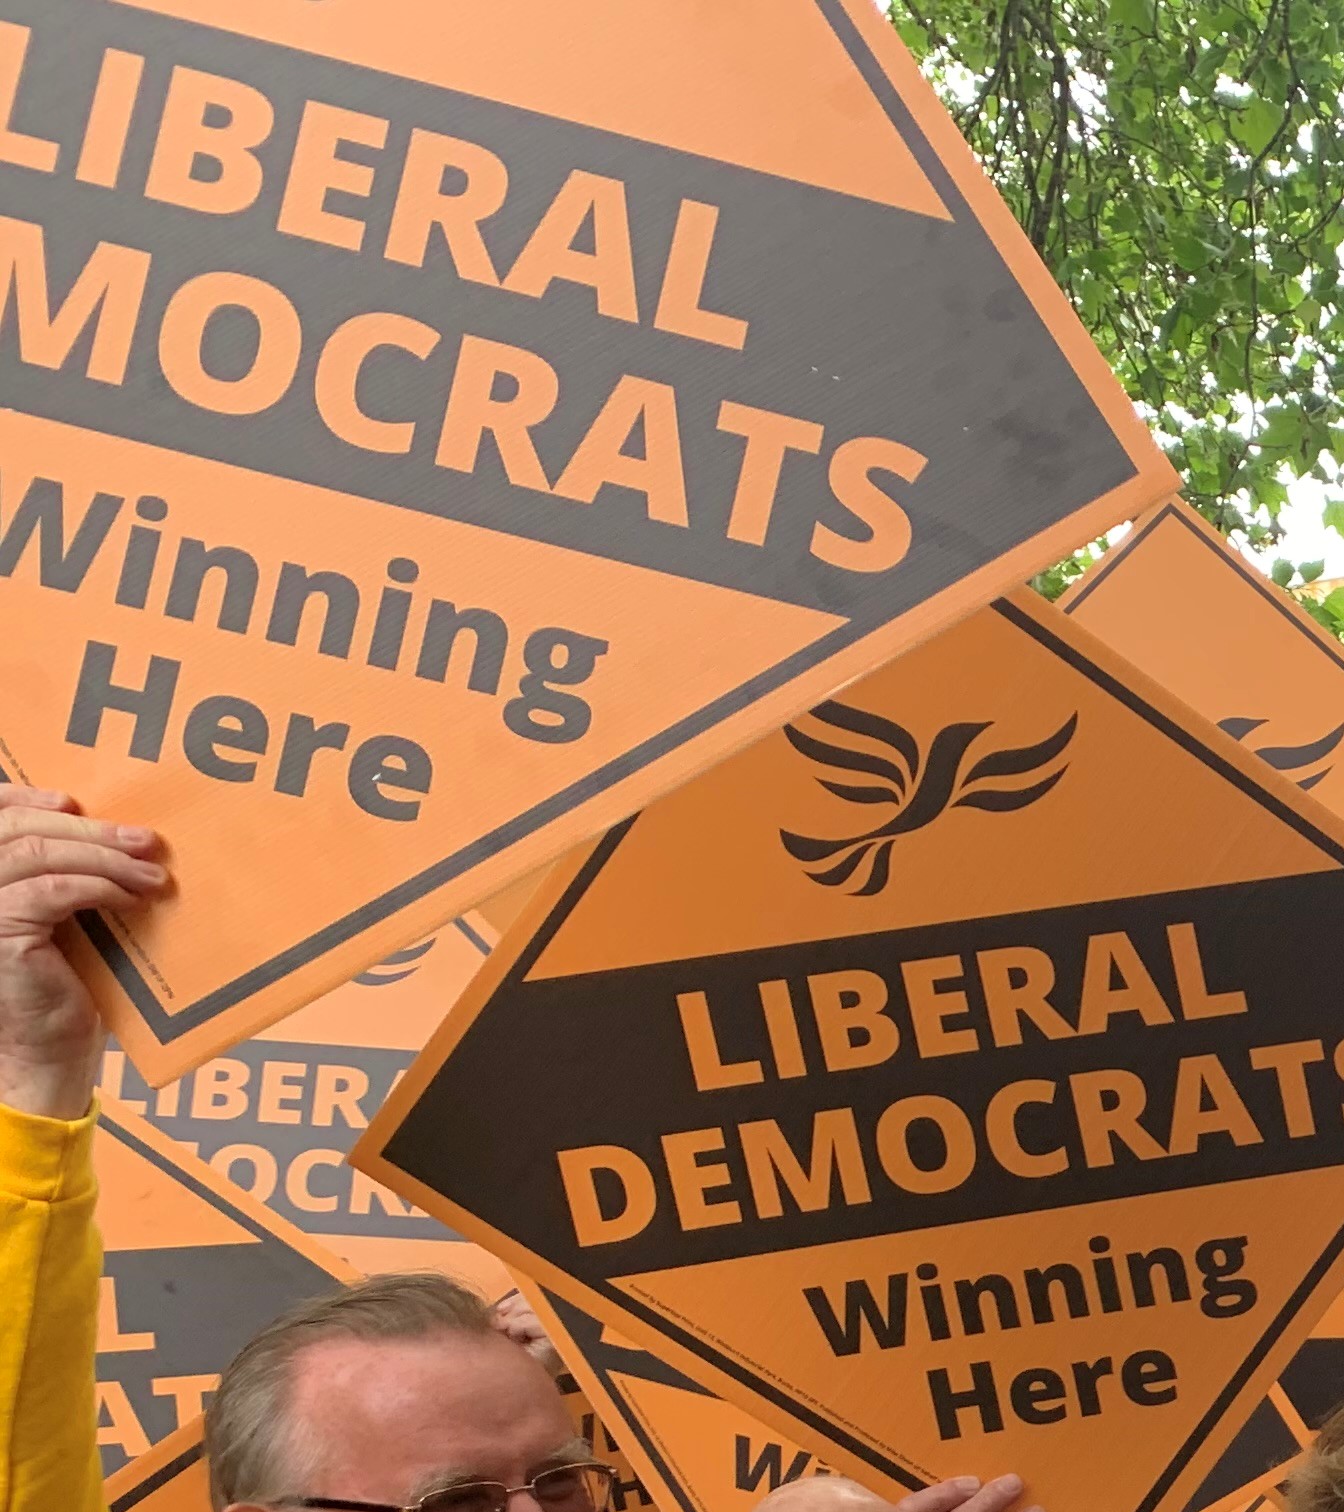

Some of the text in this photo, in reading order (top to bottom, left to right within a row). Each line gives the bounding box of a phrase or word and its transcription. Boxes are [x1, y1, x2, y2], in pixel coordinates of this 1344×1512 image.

[0, 475, 609, 744] Winning
[64, 639, 433, 822] Here
[676, 923, 1249, 1093] LIBERAL
[803, 1234, 1259, 1360] Winning
[926, 1349, 1179, 1443] Here
